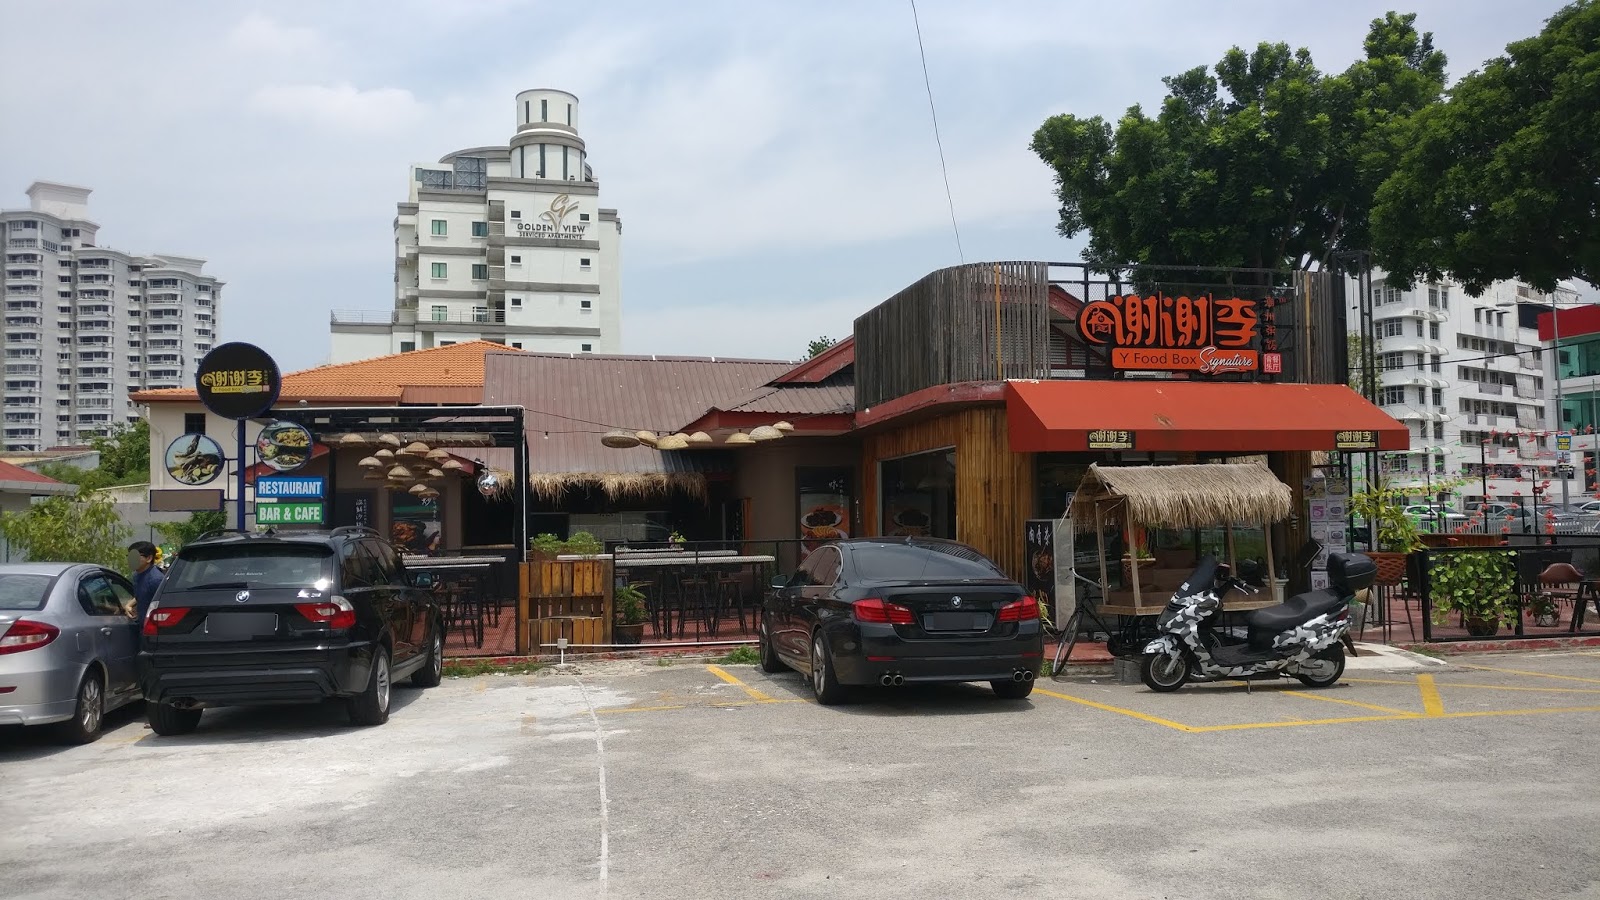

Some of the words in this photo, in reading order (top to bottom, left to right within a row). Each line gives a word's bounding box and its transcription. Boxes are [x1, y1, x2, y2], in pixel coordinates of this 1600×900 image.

[517, 223, 553, 232] GOLDEN
[563, 225, 585, 233] VIEW
[1120, 353, 1129, 364] Y
[1134, 352, 1167, 364] Food
[1172, 353, 1197, 365] Box
[1199, 346, 1253, 373] Signature
[258, 481, 322, 495] RESTAURANT
[259, 507, 282, 521] BAR
[283, 507, 292, 520] &
[294, 506, 320, 520] CAFE
